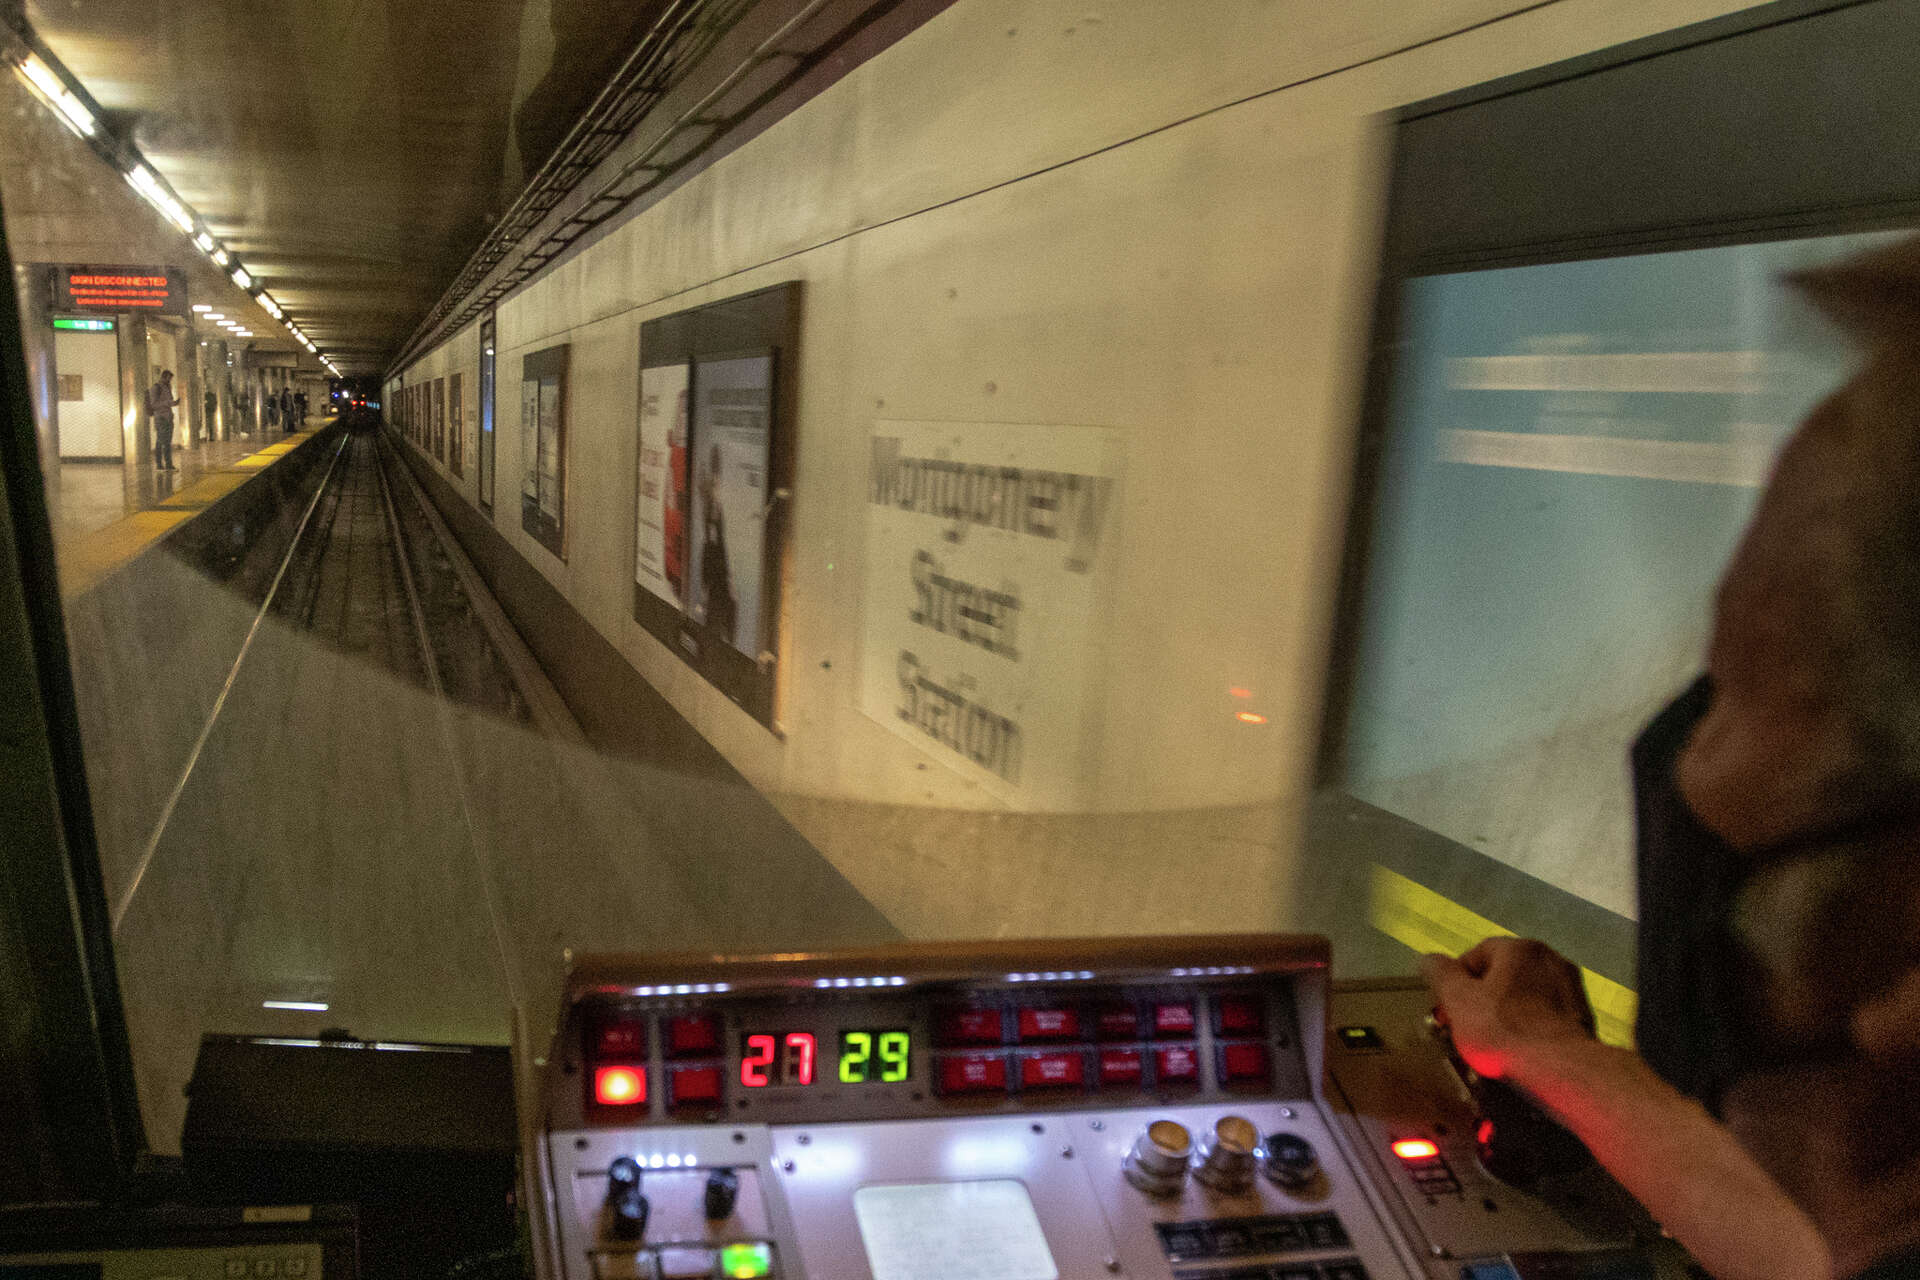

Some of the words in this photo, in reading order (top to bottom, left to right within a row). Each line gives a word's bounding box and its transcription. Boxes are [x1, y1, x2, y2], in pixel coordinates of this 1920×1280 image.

[94, 275, 168, 287] DISCONNECTED
[741, 1033, 815, 1087] 27
[839, 1032, 909, 1083] 29
